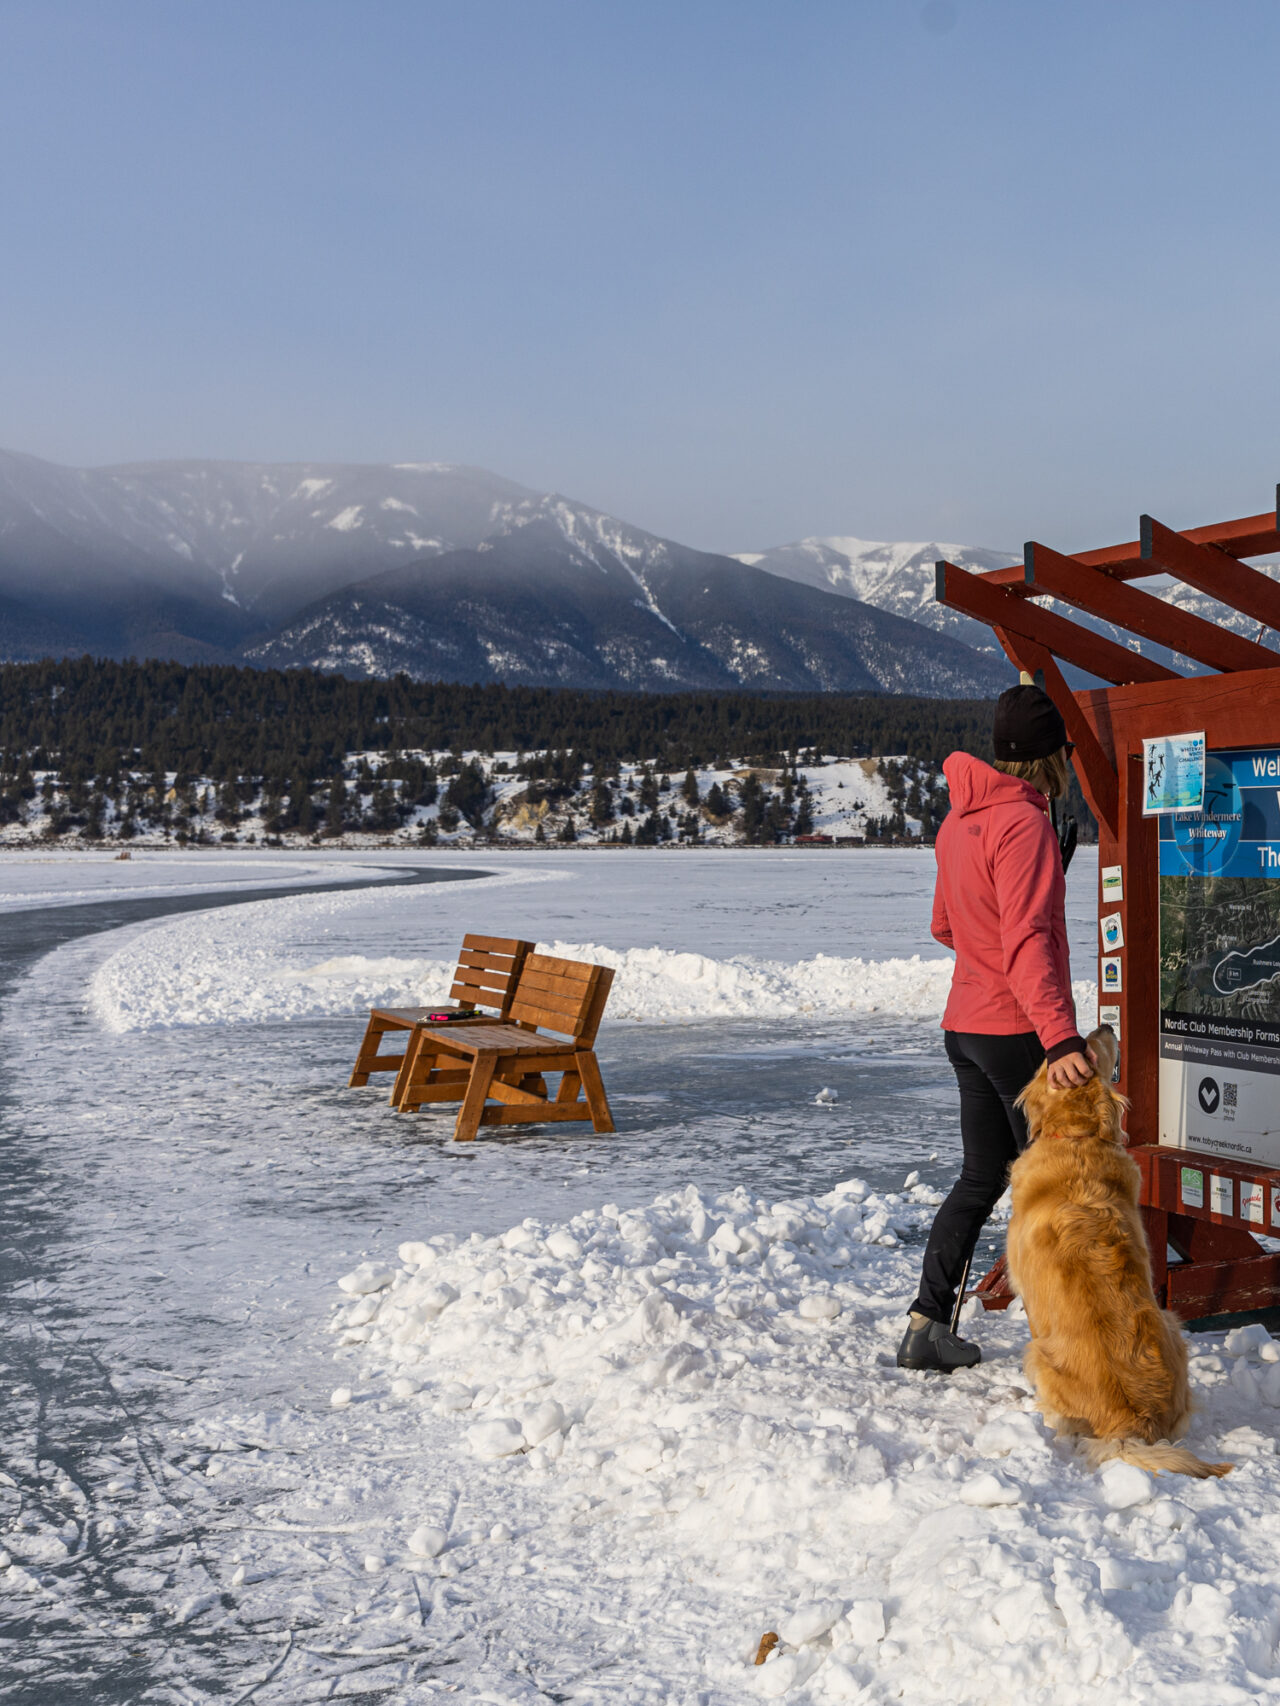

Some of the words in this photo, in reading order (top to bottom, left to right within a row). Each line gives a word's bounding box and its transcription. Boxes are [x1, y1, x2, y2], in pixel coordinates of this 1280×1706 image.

[1175, 812, 1193, 822] Lake
[1188, 827, 1228, 840] Whiteway
[1165, 1018, 1188, 1031] Nordic
[1189, 1021, 1206, 1033] Club
[1208, 1024, 1254, 1042] Membership
[1256, 1029, 1280, 1042] Forms
[1165, 1042, 1183, 1051] Annual
[1184, 1043, 1210, 1057] Whiteway
[1210, 1047, 1222, 1057] Pass
[1223, 1048, 1236, 1058] with
[1237, 1051, 1249, 1060] Club
[1188, 1134, 1252, 1154] www.tobycreeknordic.ca
